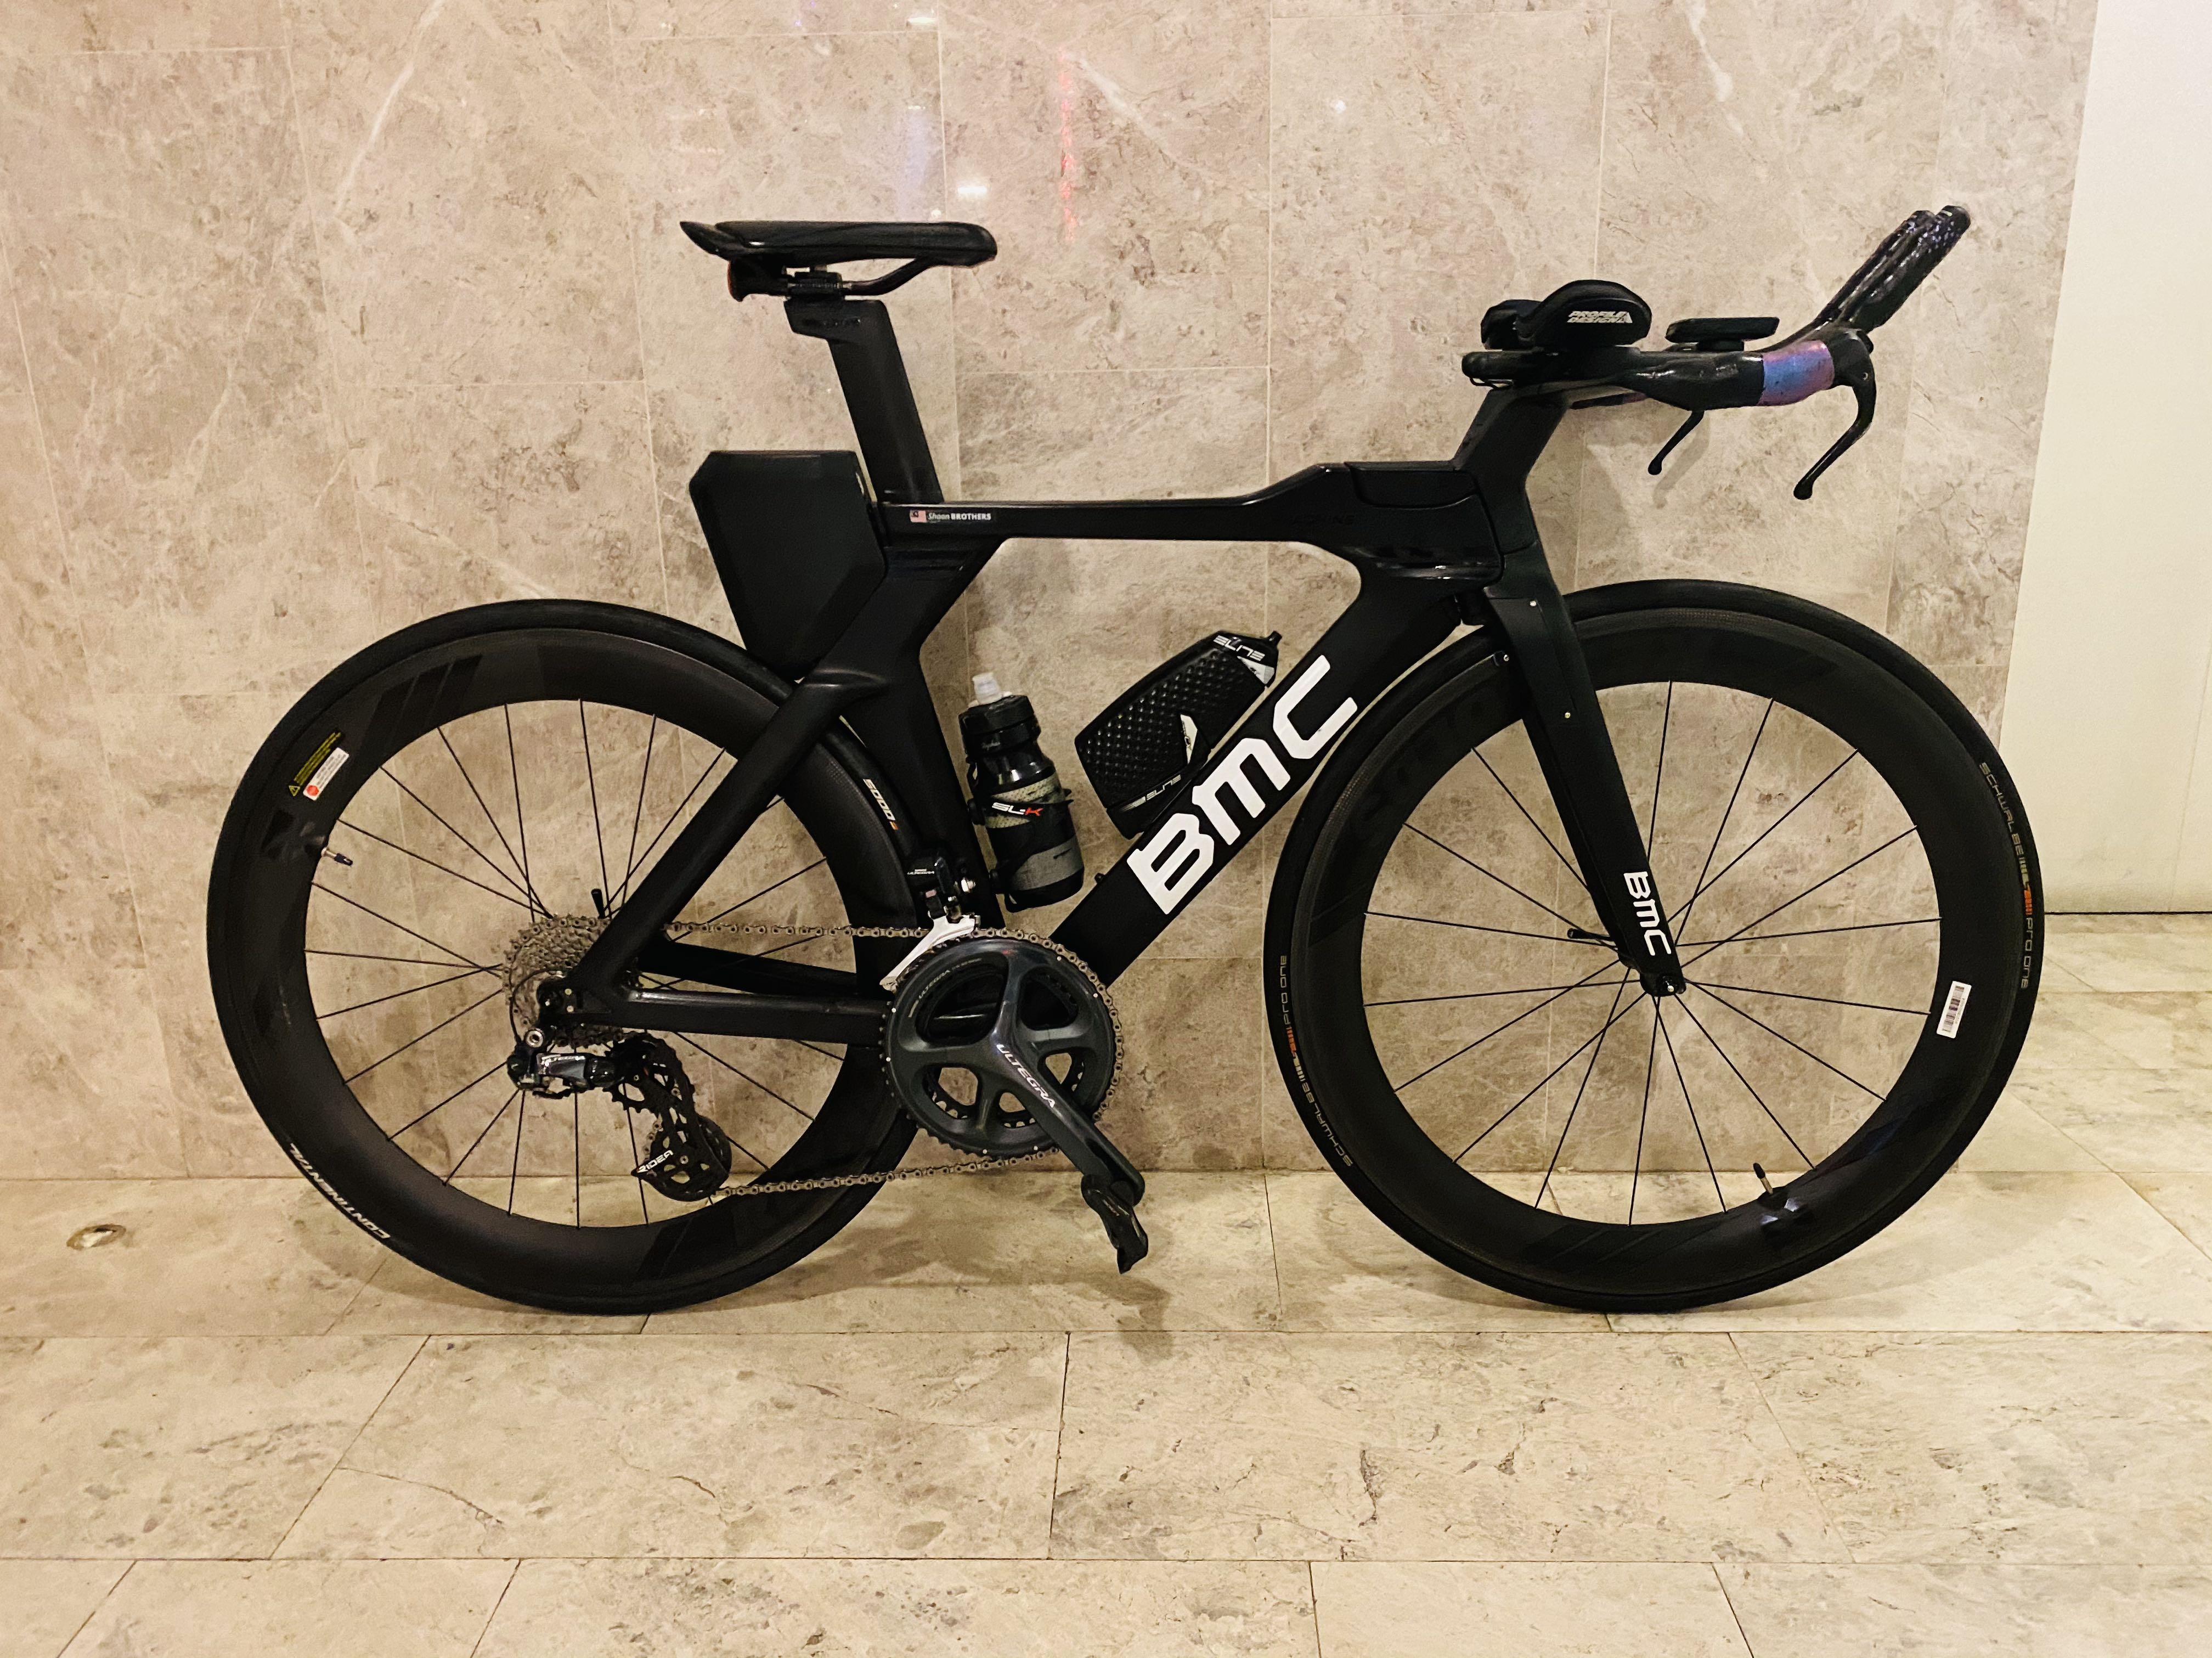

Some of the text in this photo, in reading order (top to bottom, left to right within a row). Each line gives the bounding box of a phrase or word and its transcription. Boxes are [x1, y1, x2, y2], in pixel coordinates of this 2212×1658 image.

[863, 779, 896, 821] 5000
[1127, 655, 1358, 915] BMC
[1979, 762, 2024, 855] SCHWALBE
[1623, 871, 1672, 956] BMC
[996, 1044, 1056, 1108] ULTEGRA
[637, 1149, 674, 1174] RIDEA
[1302, 1081, 1353, 1167] SCHWALBE
[290, 1142, 391, 1239] CONTINENTAL
